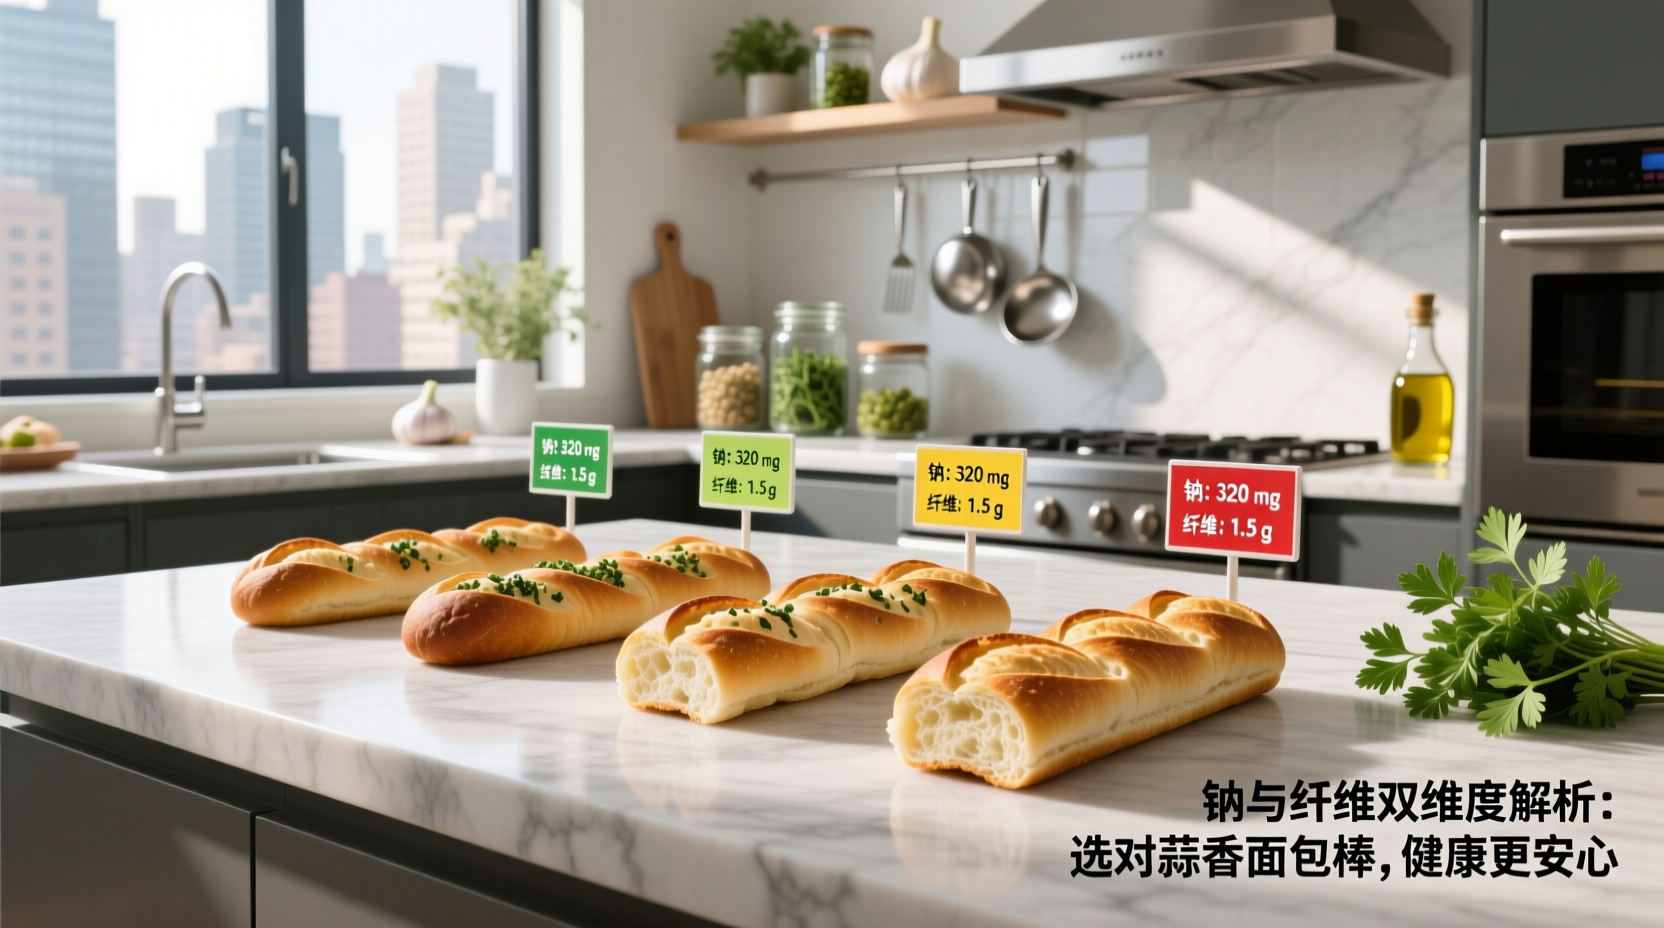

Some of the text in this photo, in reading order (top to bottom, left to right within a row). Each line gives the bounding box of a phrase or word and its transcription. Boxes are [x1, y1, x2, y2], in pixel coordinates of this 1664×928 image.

[561, 439, 582, 456] 320
[735, 450, 759, 465] 320
[762, 456, 780, 472] mg
[955, 465, 984, 482] 320
[987, 472, 1009, 490] mg
[1216, 482, 1250, 503] 320
[1254, 491, 1281, 511] mg
